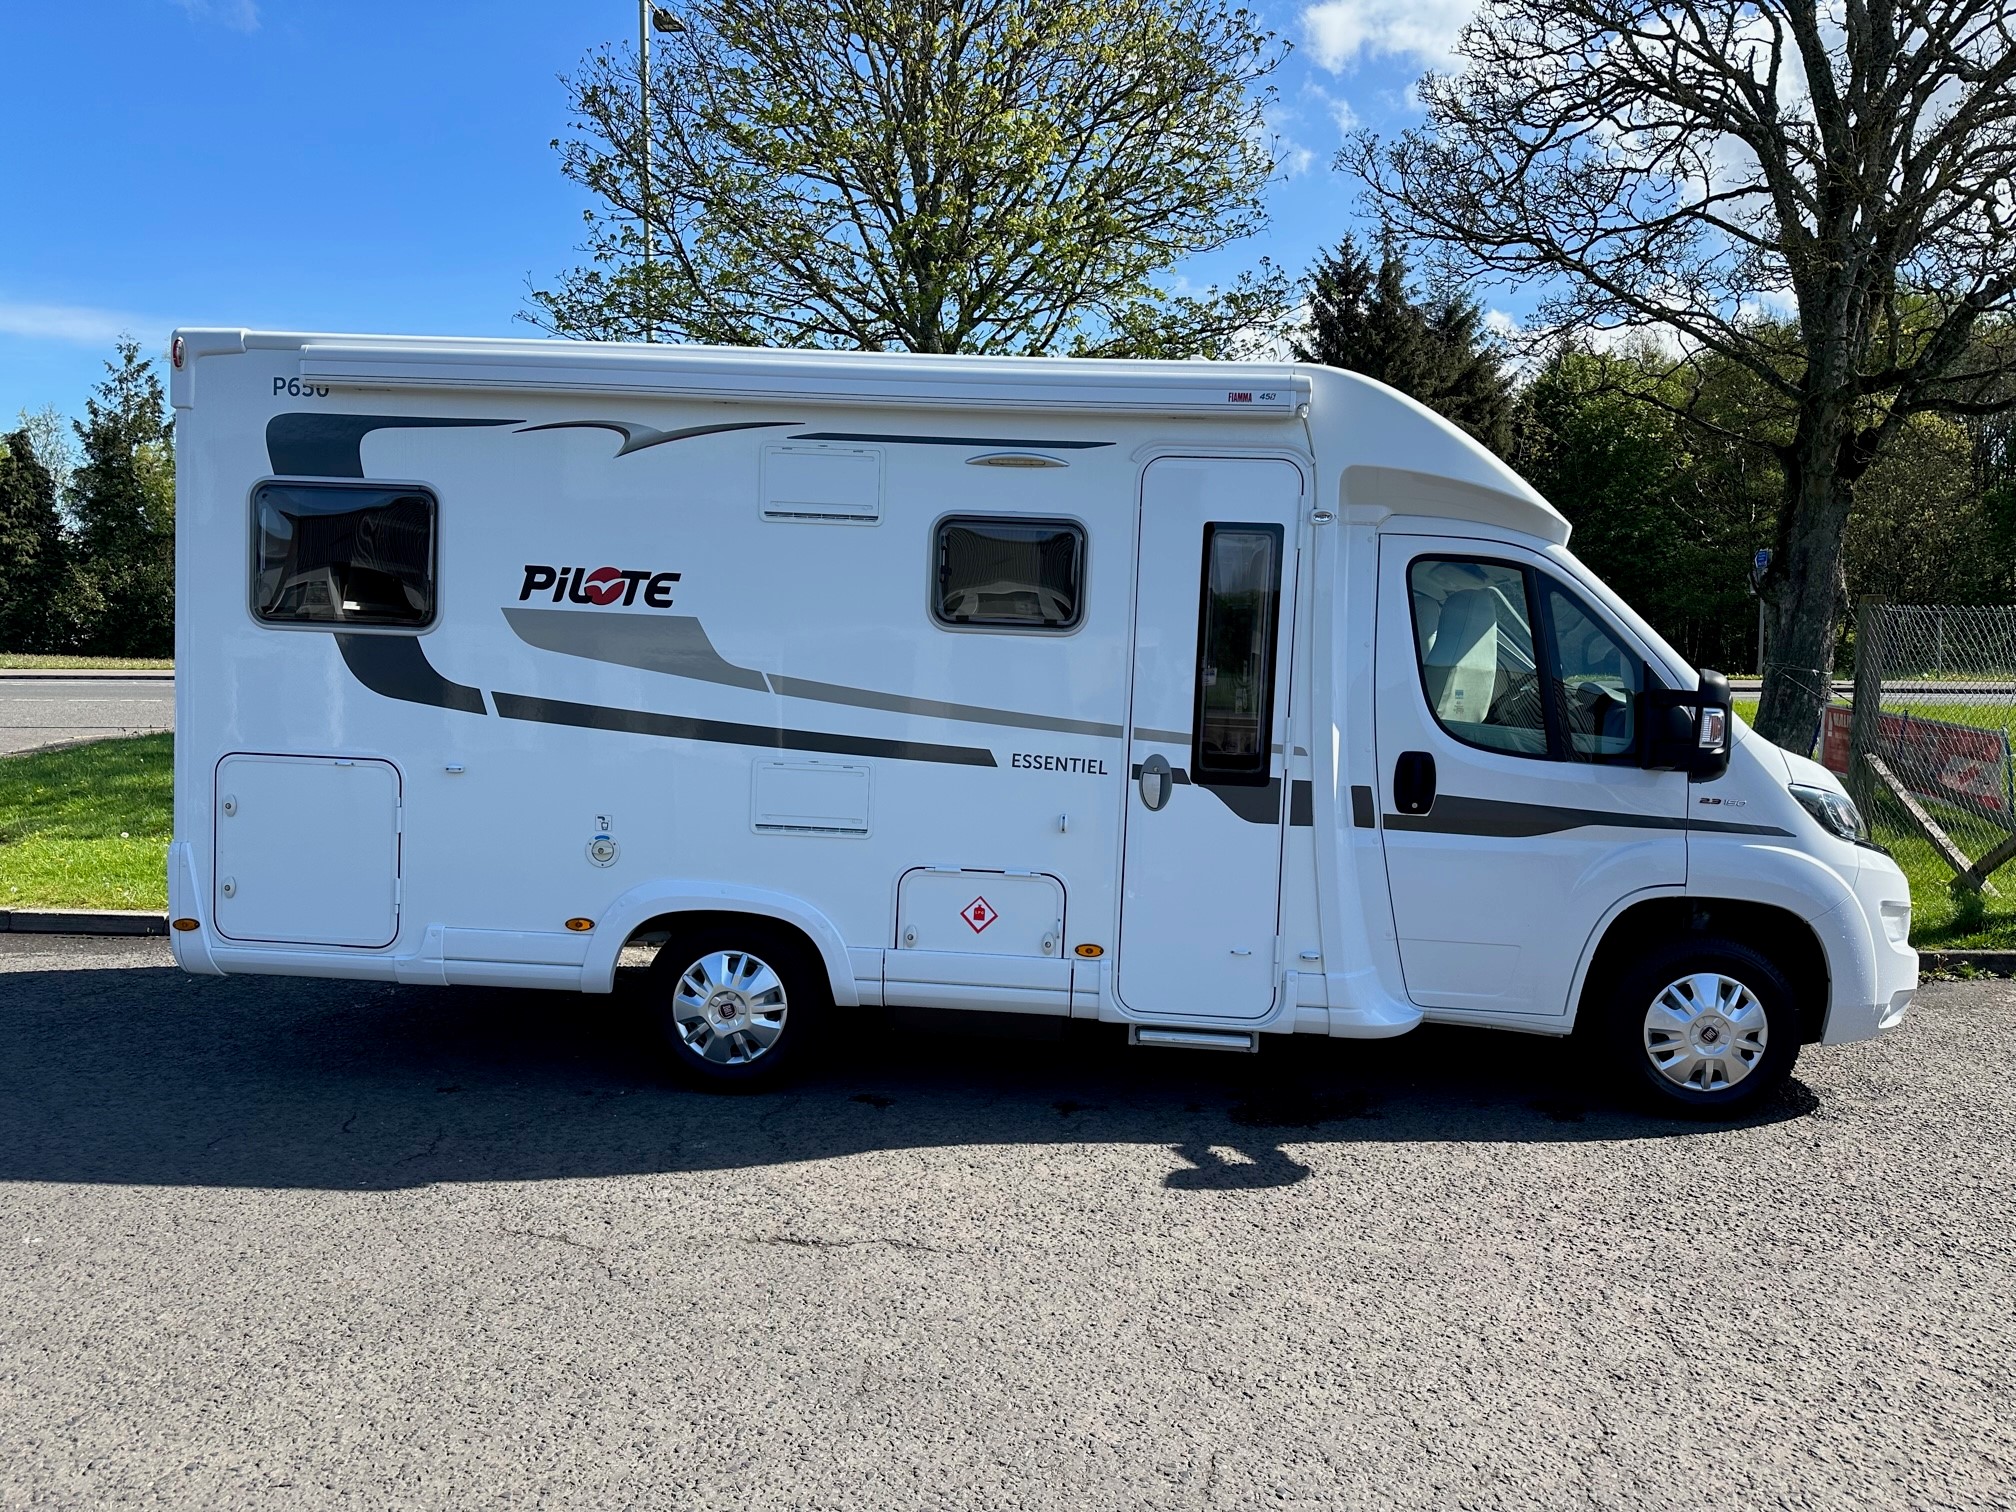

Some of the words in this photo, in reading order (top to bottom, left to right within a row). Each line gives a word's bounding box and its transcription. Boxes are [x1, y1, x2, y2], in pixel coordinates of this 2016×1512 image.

[273, 376, 330, 398] P650
[1228, 392, 1252, 403] FIAMMA
[1011, 753, 1108, 775] ESSENTIEL
